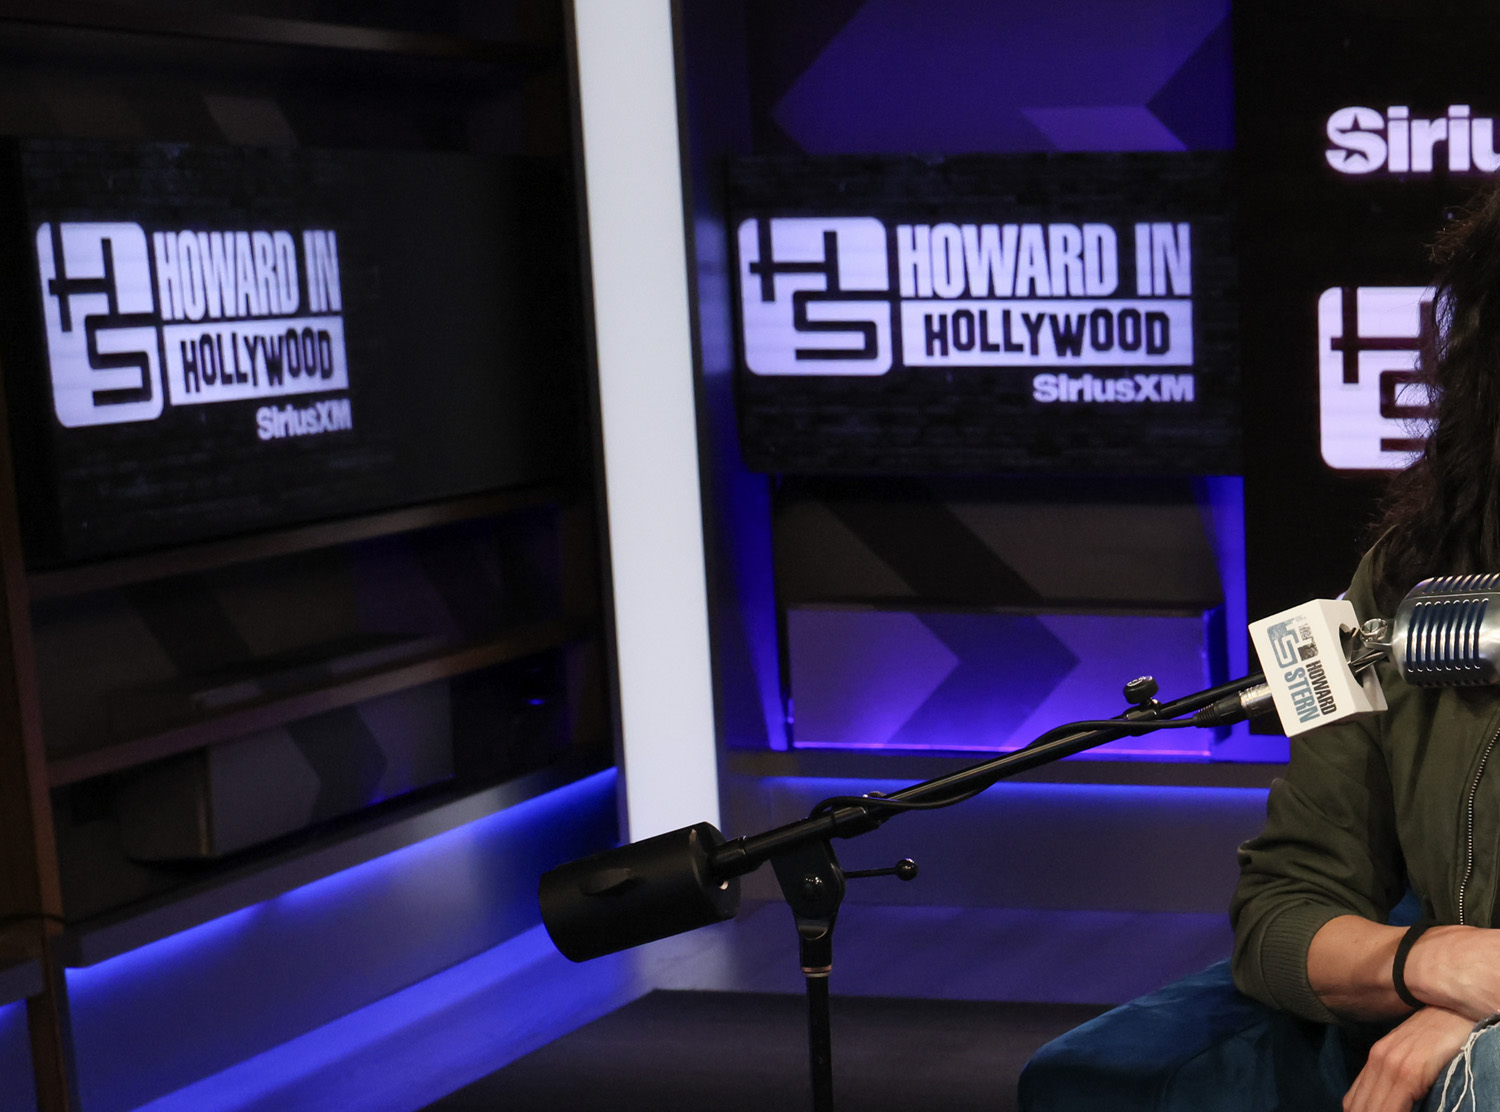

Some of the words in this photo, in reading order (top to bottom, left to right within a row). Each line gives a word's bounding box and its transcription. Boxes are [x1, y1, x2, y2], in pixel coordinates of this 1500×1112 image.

[154, 230, 300, 322] HOWARD
[303, 230, 341, 313] IN
[897, 223, 1118, 298] HOWARD
[1135, 223, 1191, 296] IN
[924, 308, 1170, 357] HOLLYWOOD
[180, 327, 333, 394] HOLLYWOOD
[1032, 373, 1195, 403] SiriusXM
[256, 399, 352, 441] SiriusXM
[1284, 667, 1320, 723] STERN
[1306, 660, 1337, 715] HOWARD
